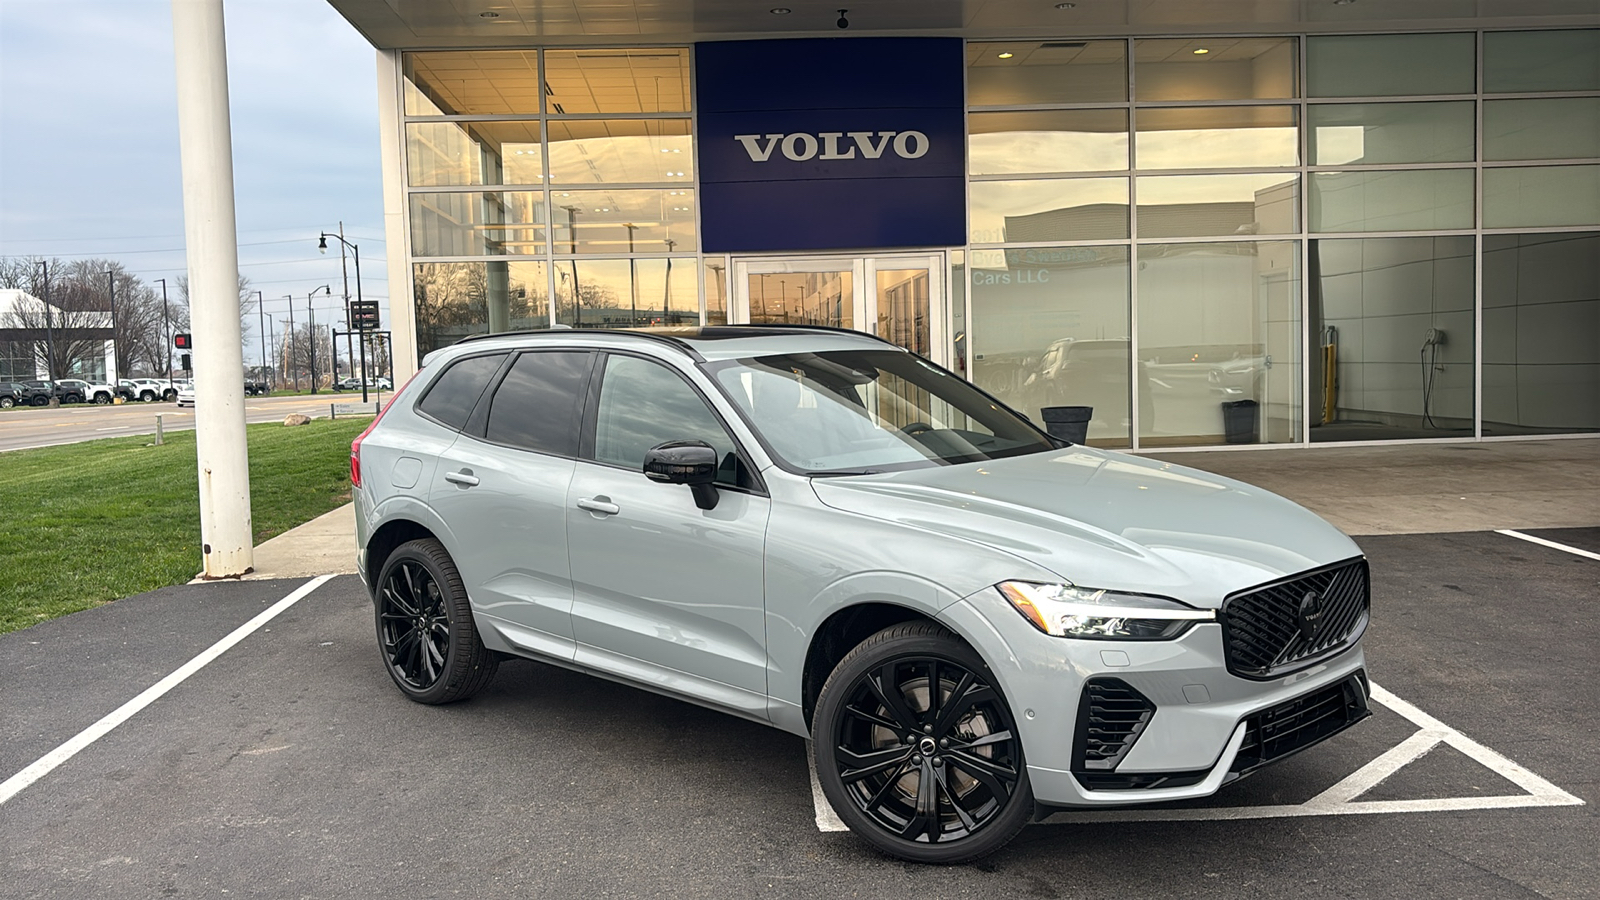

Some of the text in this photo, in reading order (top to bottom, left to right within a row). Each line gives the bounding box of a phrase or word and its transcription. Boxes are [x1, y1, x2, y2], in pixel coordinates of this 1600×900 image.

[734, 130, 930, 162] VOLVO
[972, 269, 1049, 285] Cars LLC
